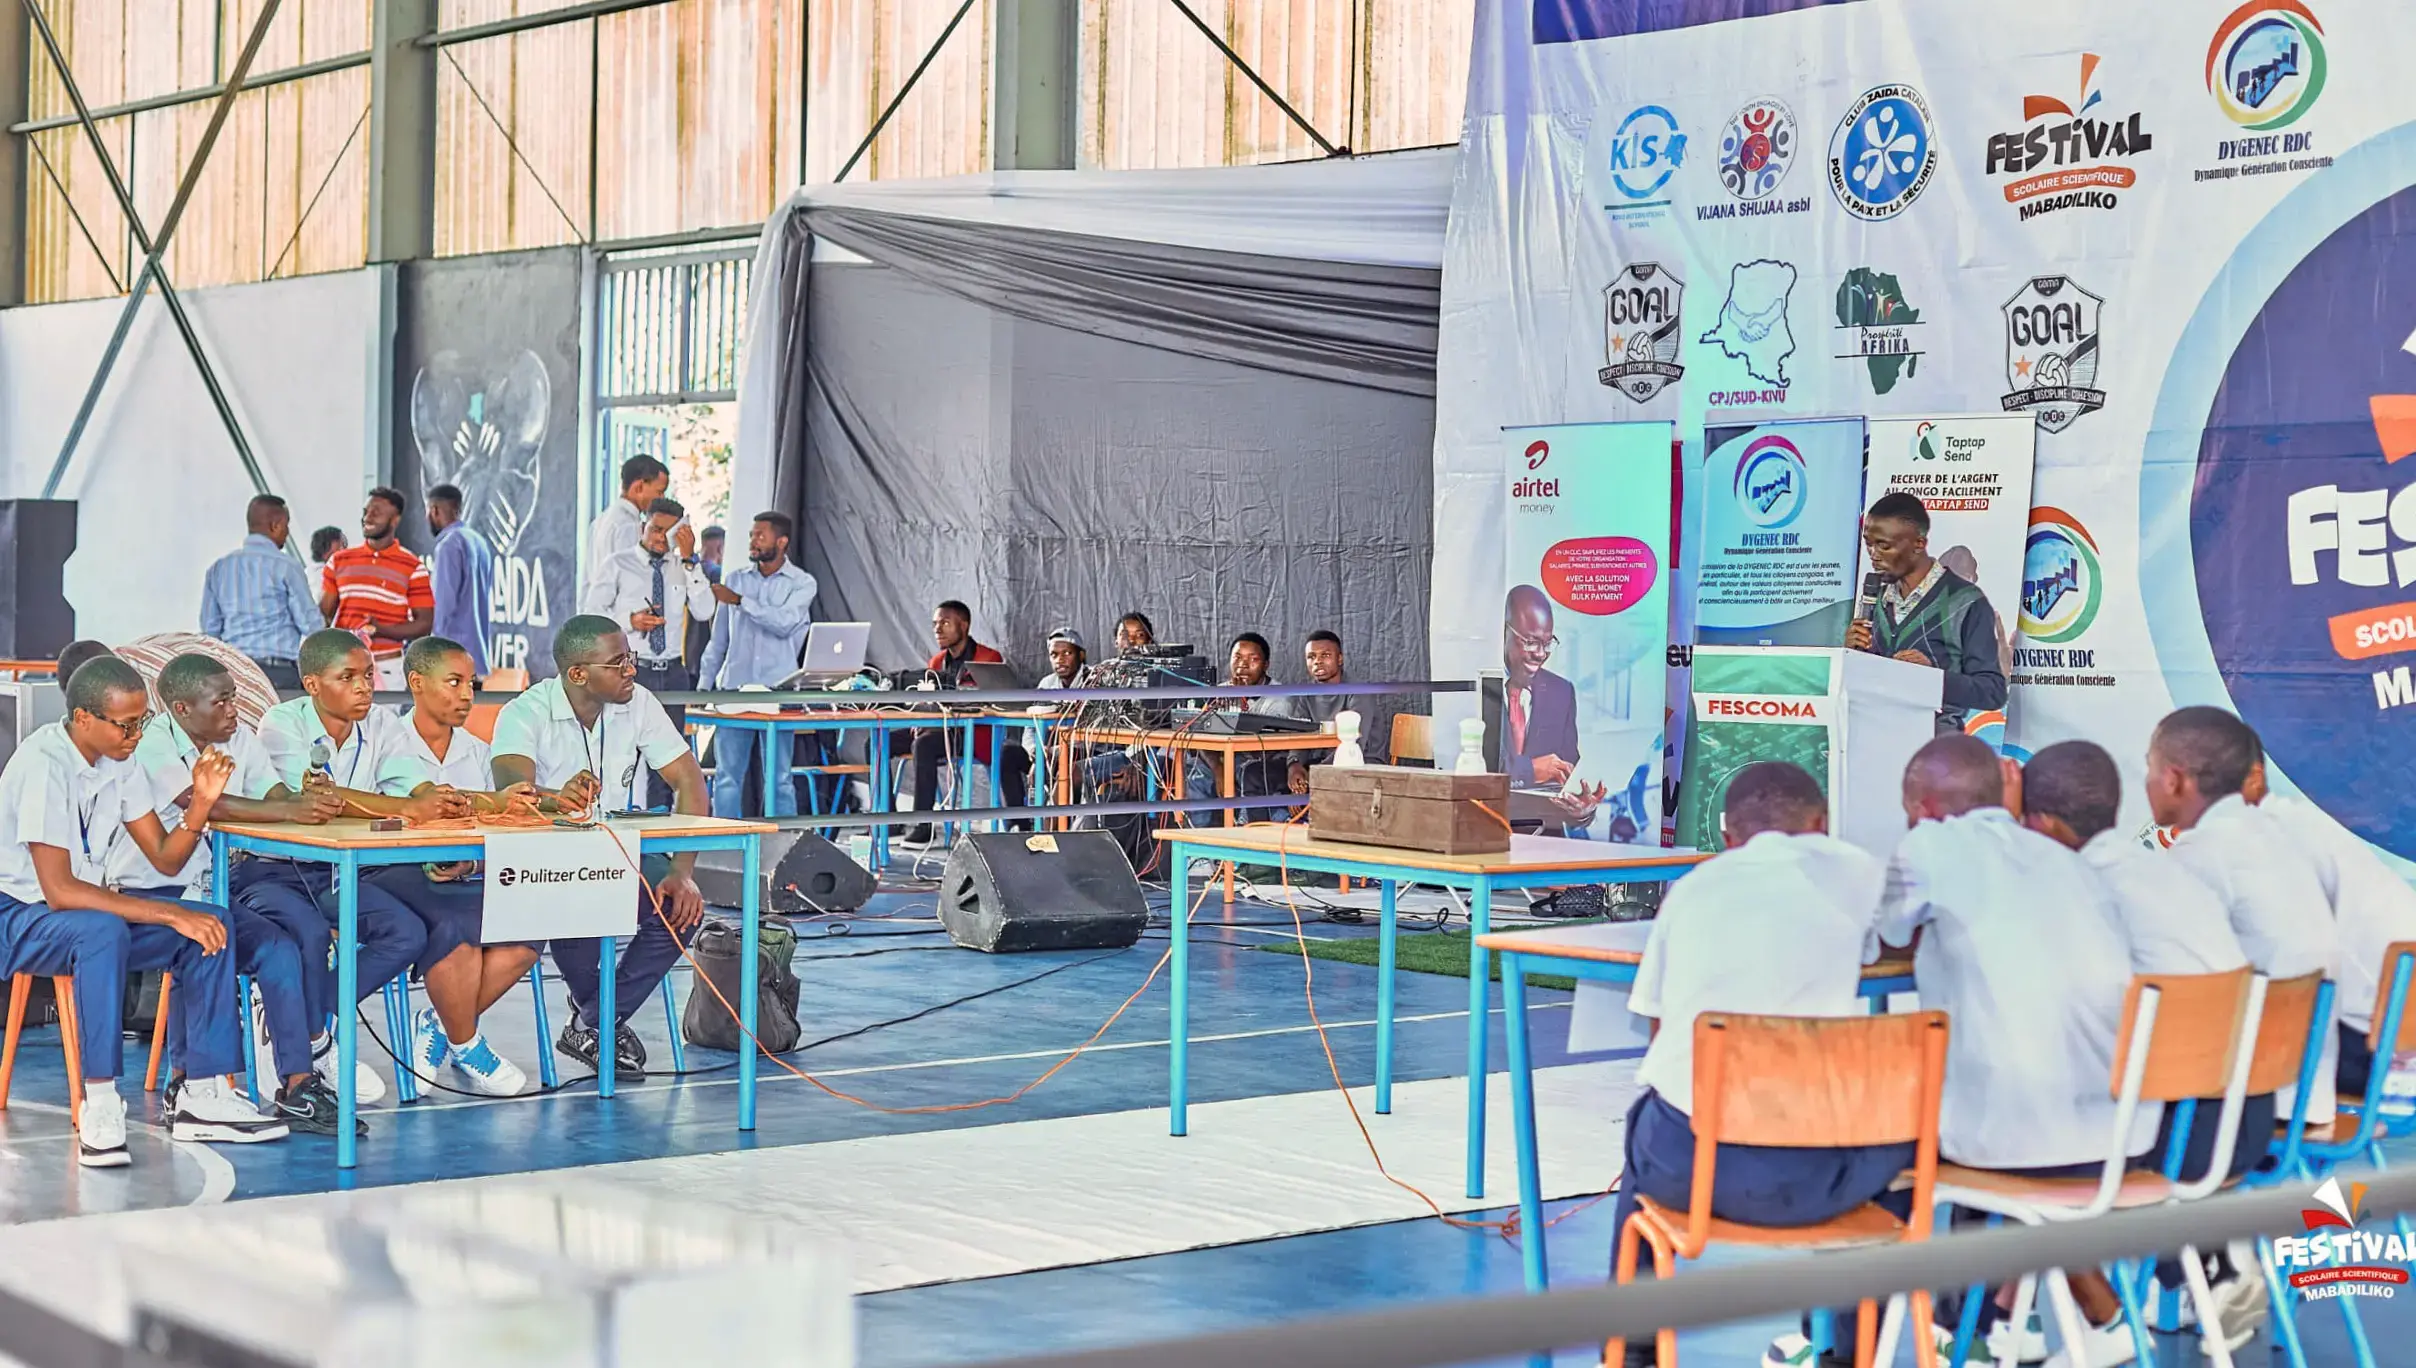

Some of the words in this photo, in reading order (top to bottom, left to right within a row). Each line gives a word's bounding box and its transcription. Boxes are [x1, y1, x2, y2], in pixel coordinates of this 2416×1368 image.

[1845, 100, 1866, 128] CLUB
[1867, 88, 1899, 104] ZAIDA
[2218, 135, 2280, 160] DYGENEC
[2283, 131, 2313, 153] RDC
[2194, 167, 2239, 183] Dynamique
[2241, 161, 2287, 176] Génération
[2289, 155, 2334, 171] Consciente
[1831, 157, 1844, 192] POUR
[1841, 190, 1852, 205] LA
[1876, 206, 1888, 216] ET
[1890, 200, 1902, 213] LA
[2013, 177, 2059, 197] SCOLAIRE
[2062, 173, 2125, 185] SCIENTIFIQUE
[1697, 203, 1736, 220] VIJANA
[1739, 199, 1784, 216] SHUJAA
[1787, 197, 1811, 213] asbl
[2019, 191, 2117, 222] MABADILIKO
[1610, 286, 1674, 325] GOAL
[2011, 301, 2090, 347] GOAL
[1860, 338, 1910, 354] AFRIKA
[1709, 389, 1786, 406] CPJ/SUD-KIVU
[2004, 392, 2030, 408] RESPECT
[2034, 388, 2067, 400] DISCIPLINE
[1946, 436, 1985, 450] Taptap
[1944, 450, 1972, 462] Send
[1512, 477, 1560, 497] airtel
[1891, 474, 1931, 484] RECEVER
[1935, 474, 1948, 484] DE
[1952, 473, 1999, 484] L'ARGENT
[1902, 487, 1939, 497] CONGO
[1942, 487, 2003, 497] FACILEMENT
[1519, 503, 1555, 516] money
[1924, 500, 1961, 510] TAPTAP
[1963, 500, 1988, 510] SEND
[1742, 533, 1780, 546] DYGENEC
[1782, 532, 1800, 546] RDC
[1744, 562, 1772, 570] DYGENEC
[1773, 562, 1785, 570] RDC
[2013, 648, 2065, 669] DYGENEC
[2069, 649, 2095, 669] RDC
[2034, 672, 2075, 686] Génération
[2077, 674, 2116, 687] Consciente
[1708, 700, 1817, 718] FESCOMA
[520, 869, 575, 884] Pulitzer
[578, 867, 626, 882] Center
